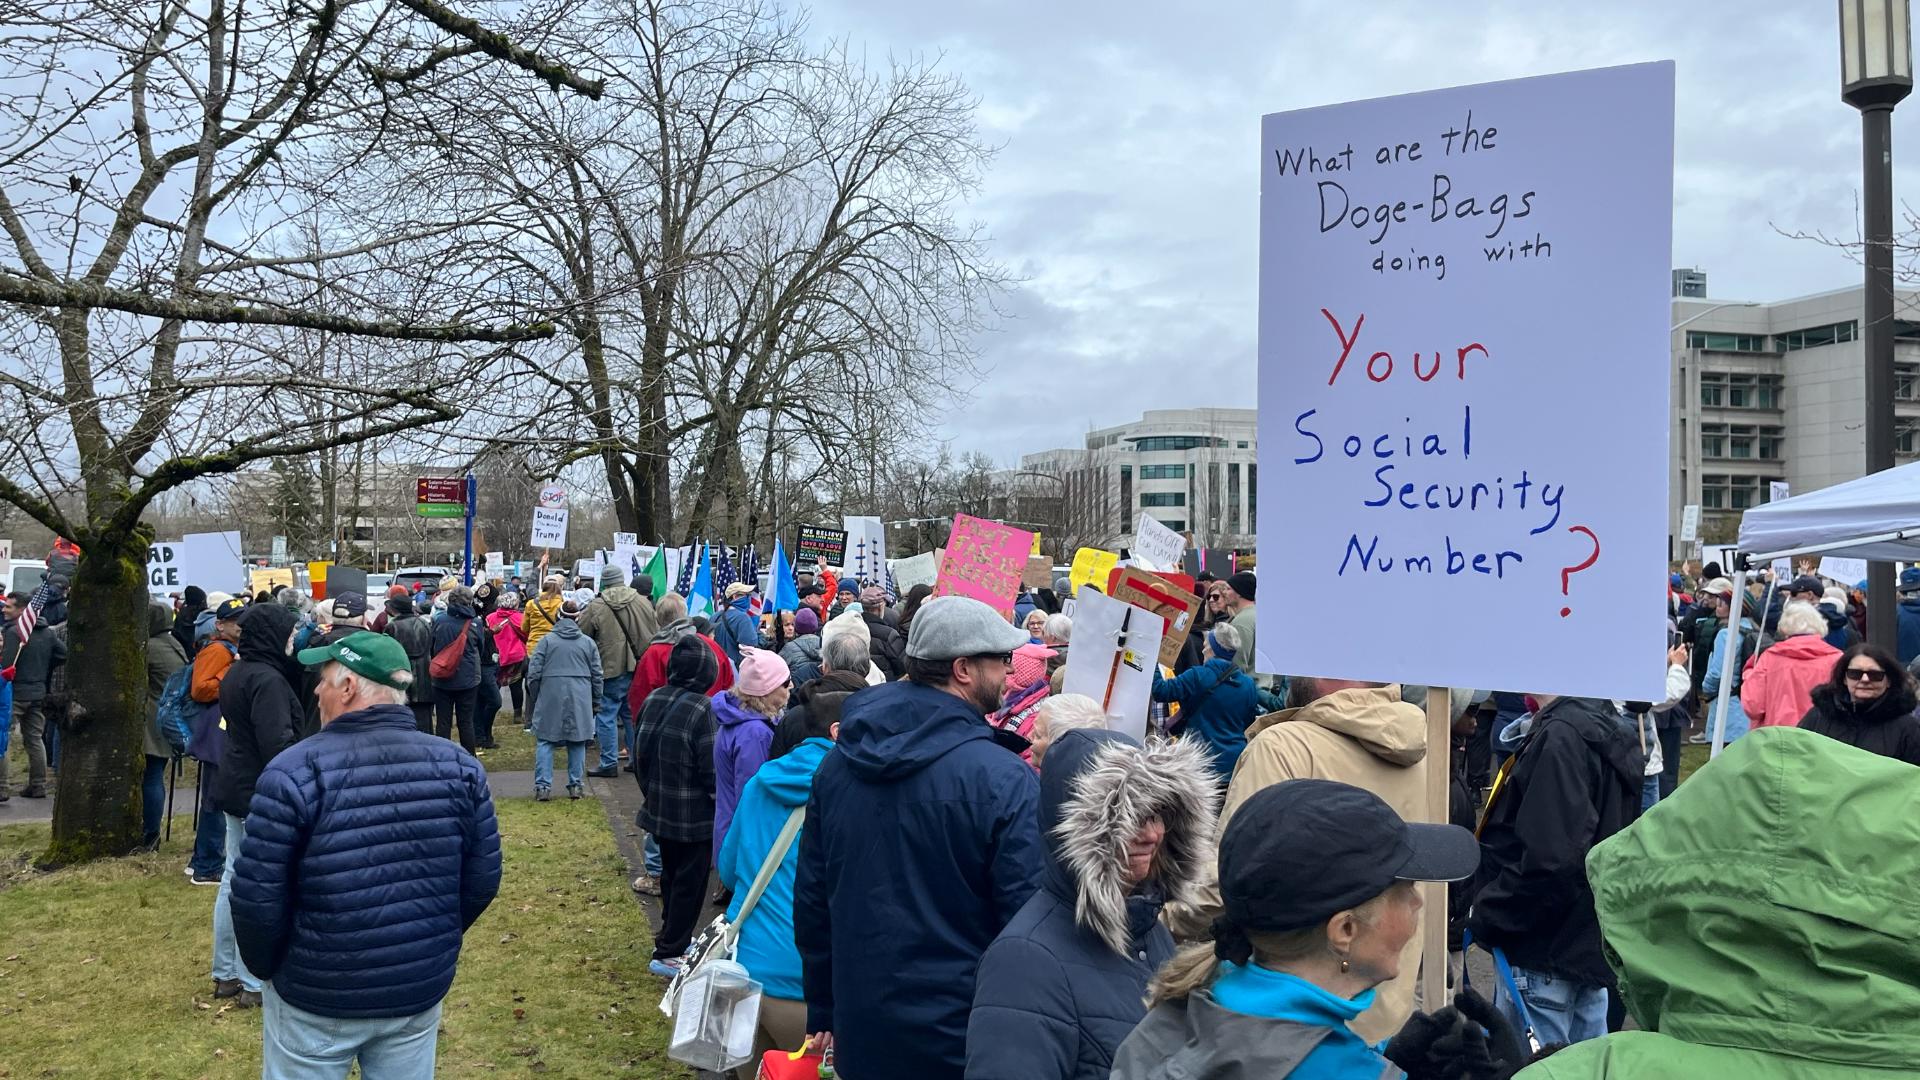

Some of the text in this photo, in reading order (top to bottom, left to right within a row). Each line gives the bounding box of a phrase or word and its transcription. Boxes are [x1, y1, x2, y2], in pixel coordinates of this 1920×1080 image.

[1276, 110, 1498, 176] What are the
[1317, 174, 1536, 245] Doge-Bags
[1372, 233, 1552, 281] doing with
[1321, 308, 1489, 386] Your
[1295, 406, 1471, 465] Social
[537, 511, 565, 522] Donald
[541, 491, 563, 503] STOP
[1364, 465, 1565, 536] Security
[535, 528, 560, 541] Trump
[816, 530, 844, 538] BELIEVE
